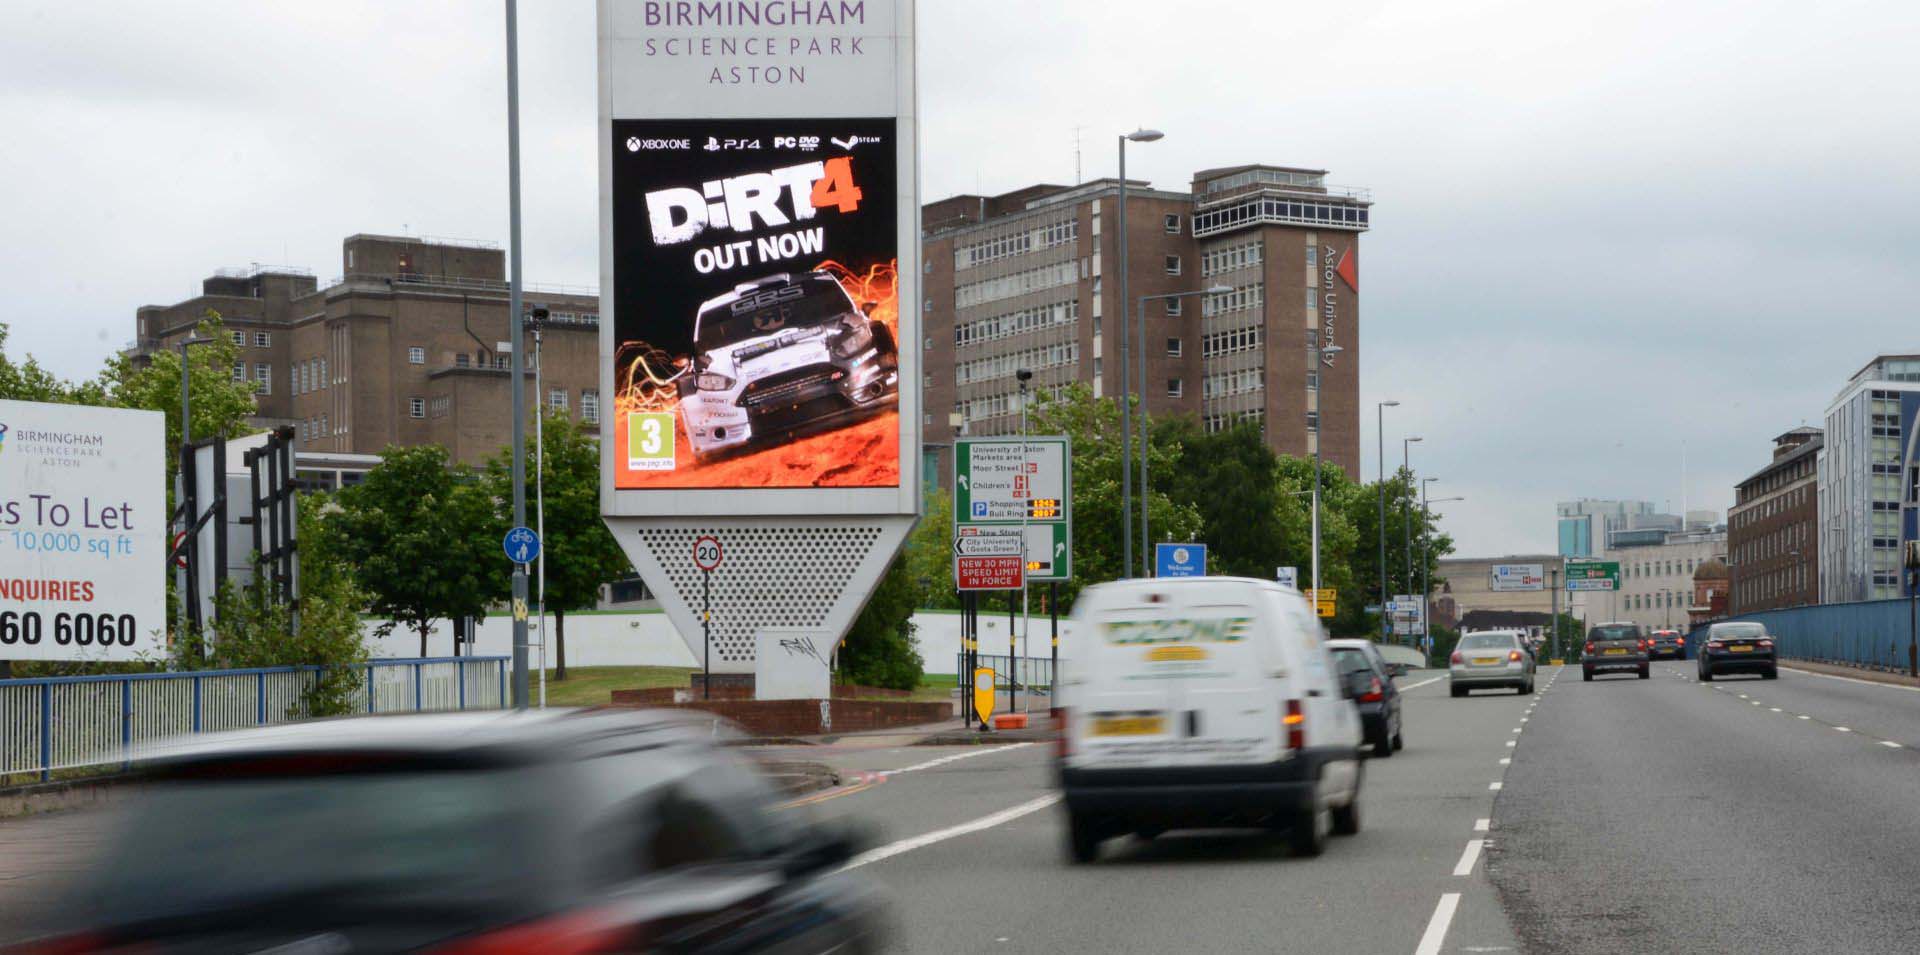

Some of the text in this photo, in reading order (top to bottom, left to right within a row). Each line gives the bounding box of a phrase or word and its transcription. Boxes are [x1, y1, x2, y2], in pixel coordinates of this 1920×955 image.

[644, 0, 865, 27] BIRMINGHAM
[645, 37, 864, 56] SCIENCE PARK
[709, 67, 806, 84] ASTON
[642, 139, 691, 149] XBOX ONE
[724, 139, 760, 150] PS4
[774, 136, 796, 149] PC
[810, 156, 862, 213] 4
[694, 227, 824, 274] OUT NOW
[1323, 245, 1337, 368] Aston Universty
[16, 430, 103, 446] BIRMINGHAM
[641, 418, 661, 454] 3
[17, 444, 103, 457] SCIENCE PARK
[42, 458, 81, 467] ASTON
[0, 494, 134, 530] s To Let
[11, 531, 133, 560] 10,000 sq ft
[699, 546, 719, 561] 20
[961, 559, 1019, 568] NEW 30 MPH
[995, 568, 1018, 576] LIMIT
[983, 577, 1012, 585] FORCE
[0, 611, 136, 646] 60 6060
